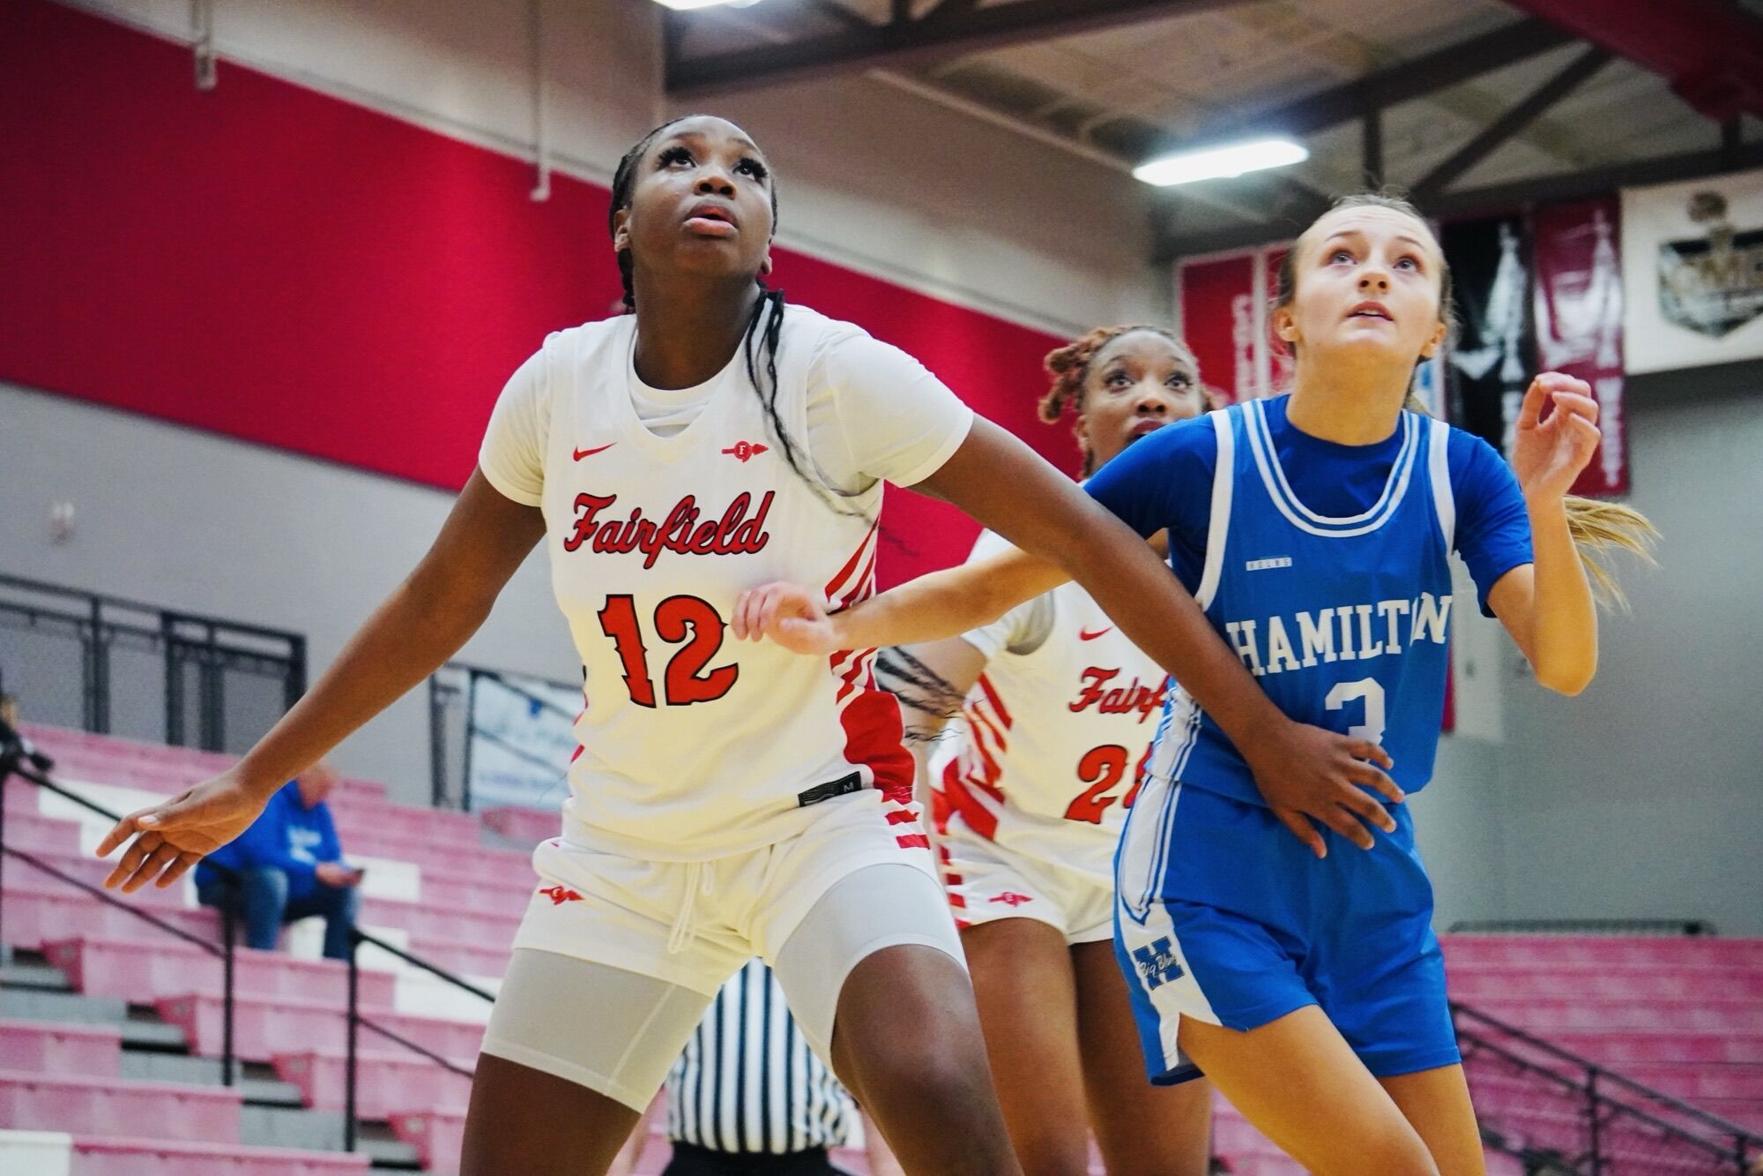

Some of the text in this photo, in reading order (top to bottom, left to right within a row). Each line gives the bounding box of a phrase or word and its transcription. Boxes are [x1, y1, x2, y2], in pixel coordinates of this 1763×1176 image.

[564, 490, 776, 569] Fairfield
[597, 593, 739, 708] 12
[1225, 591, 1453, 676] HAMILTN
[1325, 677, 1386, 746] 3
